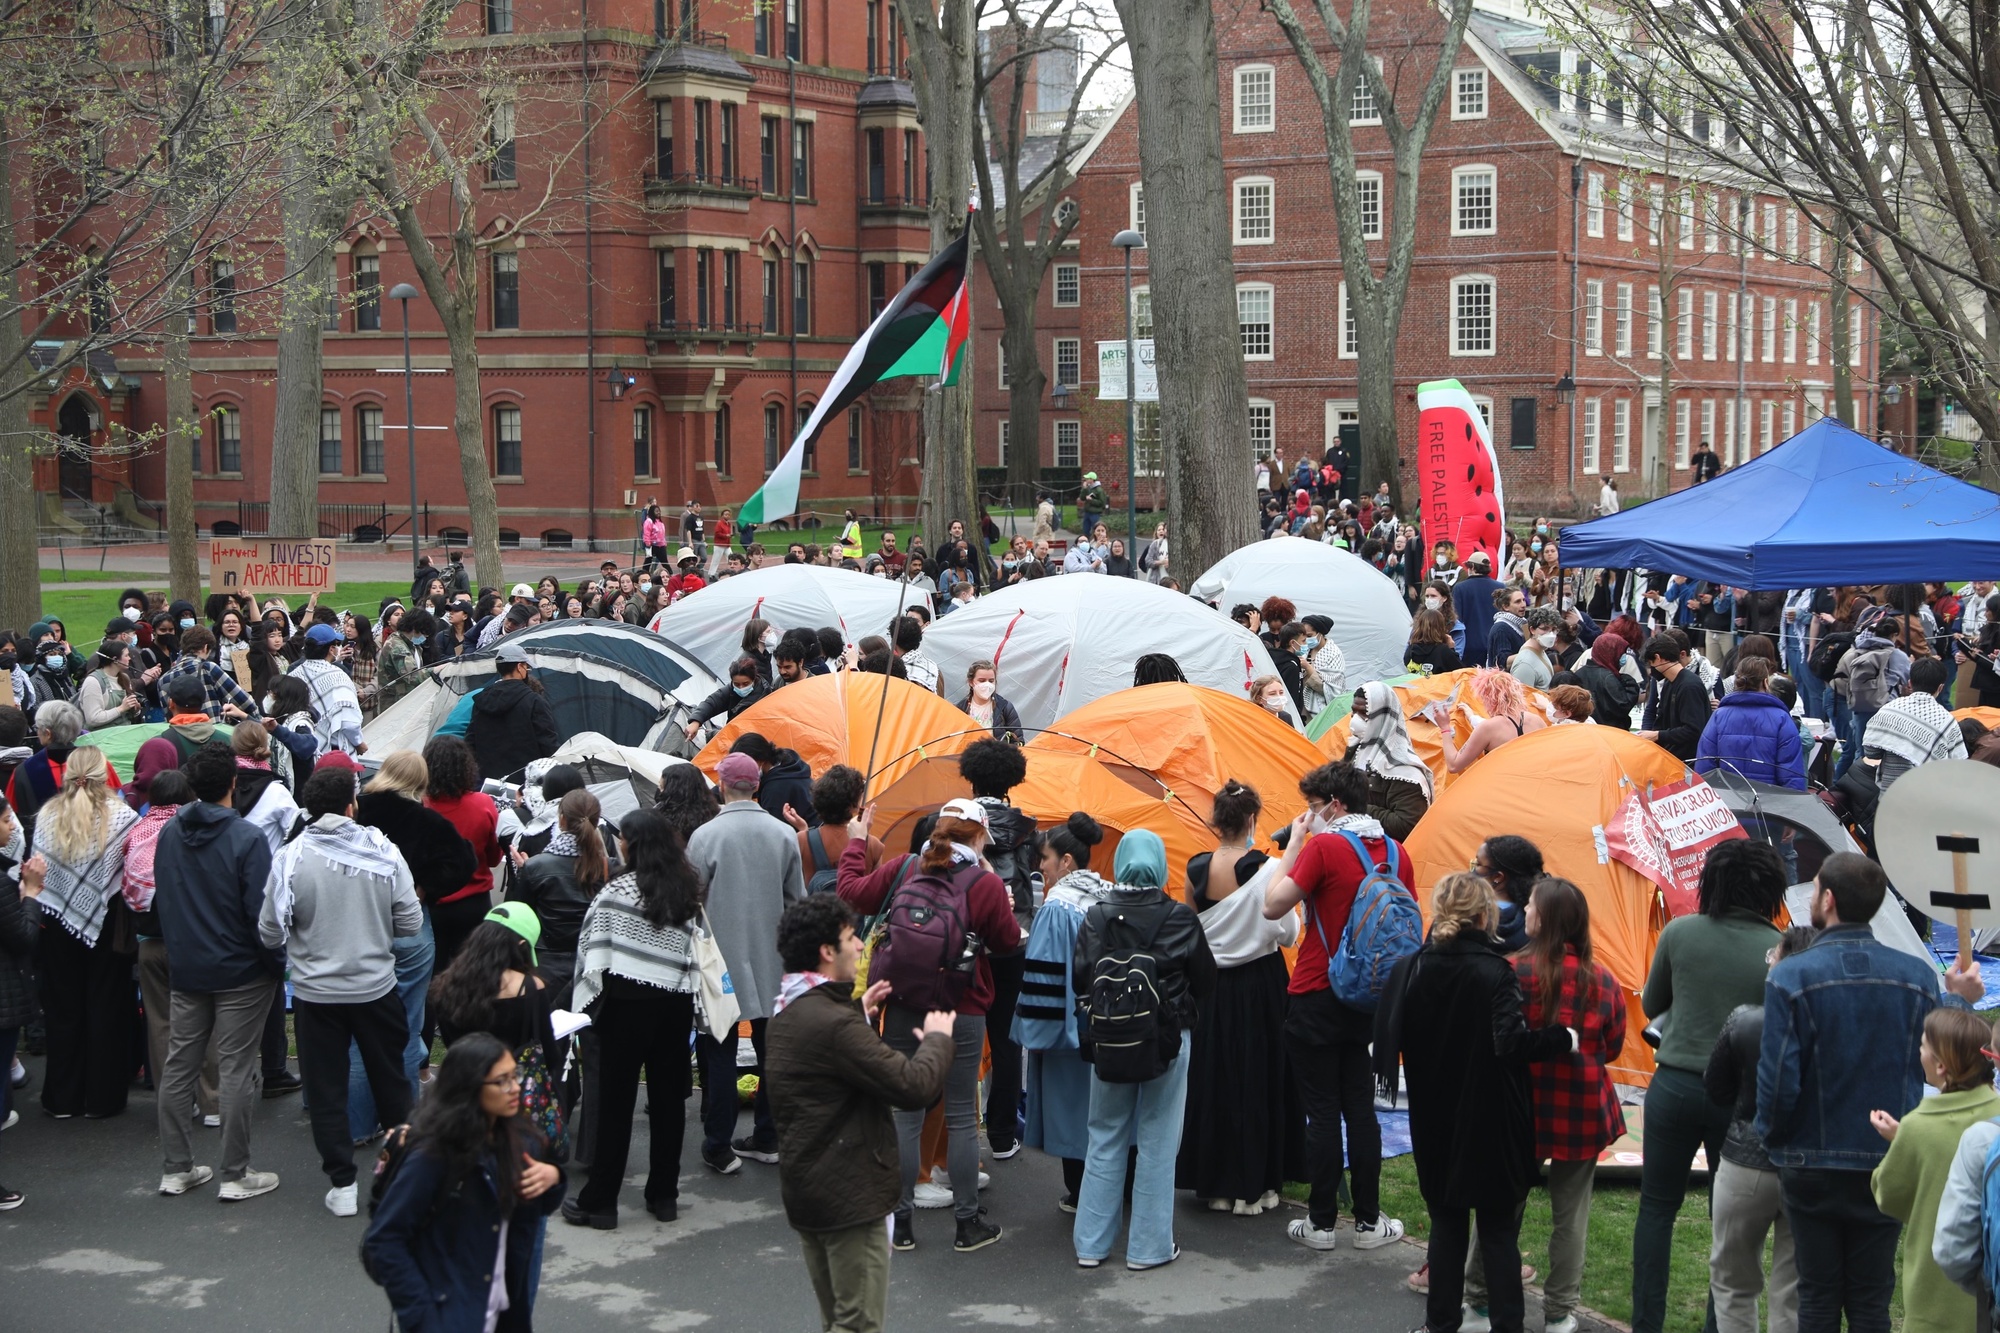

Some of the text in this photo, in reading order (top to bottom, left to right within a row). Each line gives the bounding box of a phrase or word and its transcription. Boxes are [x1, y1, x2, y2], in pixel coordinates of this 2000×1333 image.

[1102, 349, 1126, 360] ARTS
[1102, 359, 1126, 368] FIRST
[1429, 421, 1450, 543] FREE PALESTI
[269, 543, 332, 566] INVESTS
[223, 563, 328, 588] in APARTHEID!
